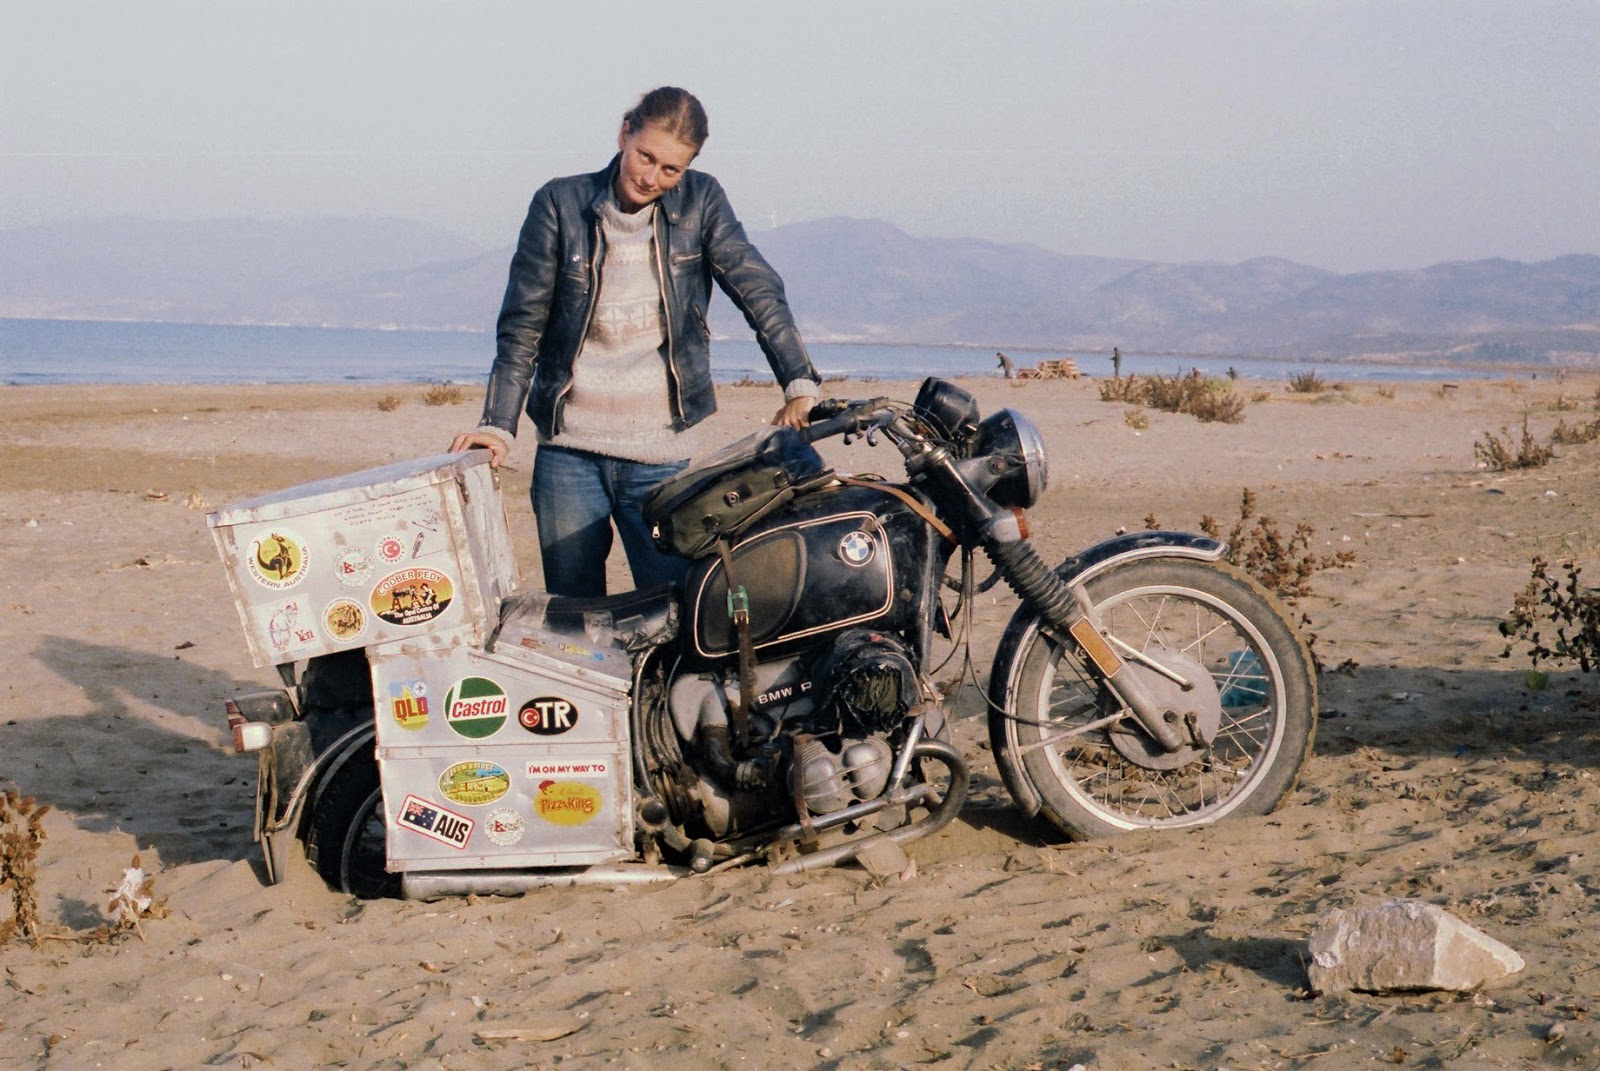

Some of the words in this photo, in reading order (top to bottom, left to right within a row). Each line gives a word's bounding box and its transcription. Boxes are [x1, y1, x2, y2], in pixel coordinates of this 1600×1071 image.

[841, 533, 872, 548] BMW
[248, 556, 281, 588] WESTERN
[284, 545, 309, 587] AUSTRALIA
[378, 571, 415, 595] COOBER
[418, 570, 443, 582] PEDY
[402, 613, 433, 624] AUSTRALIA
[294, 630, 315, 642] Yeti
[758, 687, 792, 704] BMW
[394, 696, 429, 721] QLD
[452, 698, 507, 718] Castrol
[535, 701, 571, 728] TR
[528, 764, 541, 774] I'M
[542, 765, 556, 774] ON
[557, 765, 571, 773] MY
[572, 764, 590, 773] WAY
[591, 764, 606, 772] TO
[433, 814, 470, 844] AUS
